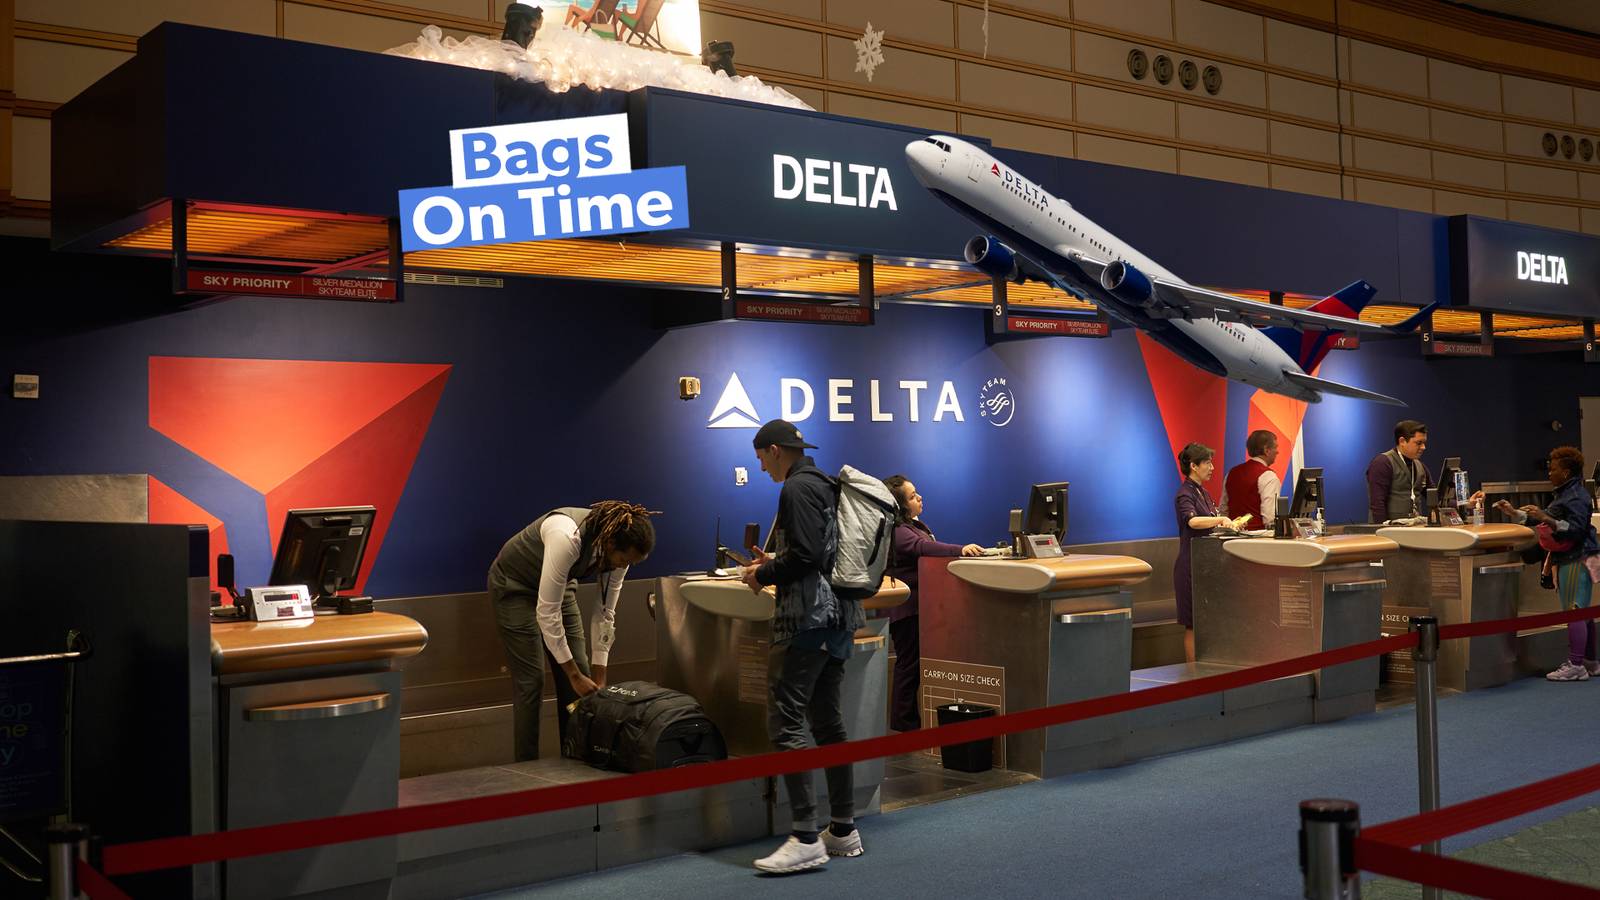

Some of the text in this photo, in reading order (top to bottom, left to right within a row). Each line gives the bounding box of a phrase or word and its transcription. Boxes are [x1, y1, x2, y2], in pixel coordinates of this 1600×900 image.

[773, 153, 898, 211] DELTA
[1004, 170, 1049, 208] DELTA
[1516, 251, 1569, 286] DELTA
[203, 275, 291, 289] SKY PRIORITY
[312, 278, 383, 289] SILVER MEDALLION
[319, 287, 377, 297] SKYTEAM ELITE
[723, 287, 730, 300] 2
[746, 305, 802, 316] SKY PRIORITY
[995, 304, 1002, 316] 3
[1015, 320, 1058, 329] SKY PRIORITY
[1423, 333, 1430, 342] 5
[1586, 343, 1592, 351] 6
[780, 377, 965, 422] DELTA
[980, 377, 1006, 417] SKYTEAM
[1386, 614, 1400, 622] SIZE
[923, 669, 1001, 687] CARRY-ON SIZE CHECK
